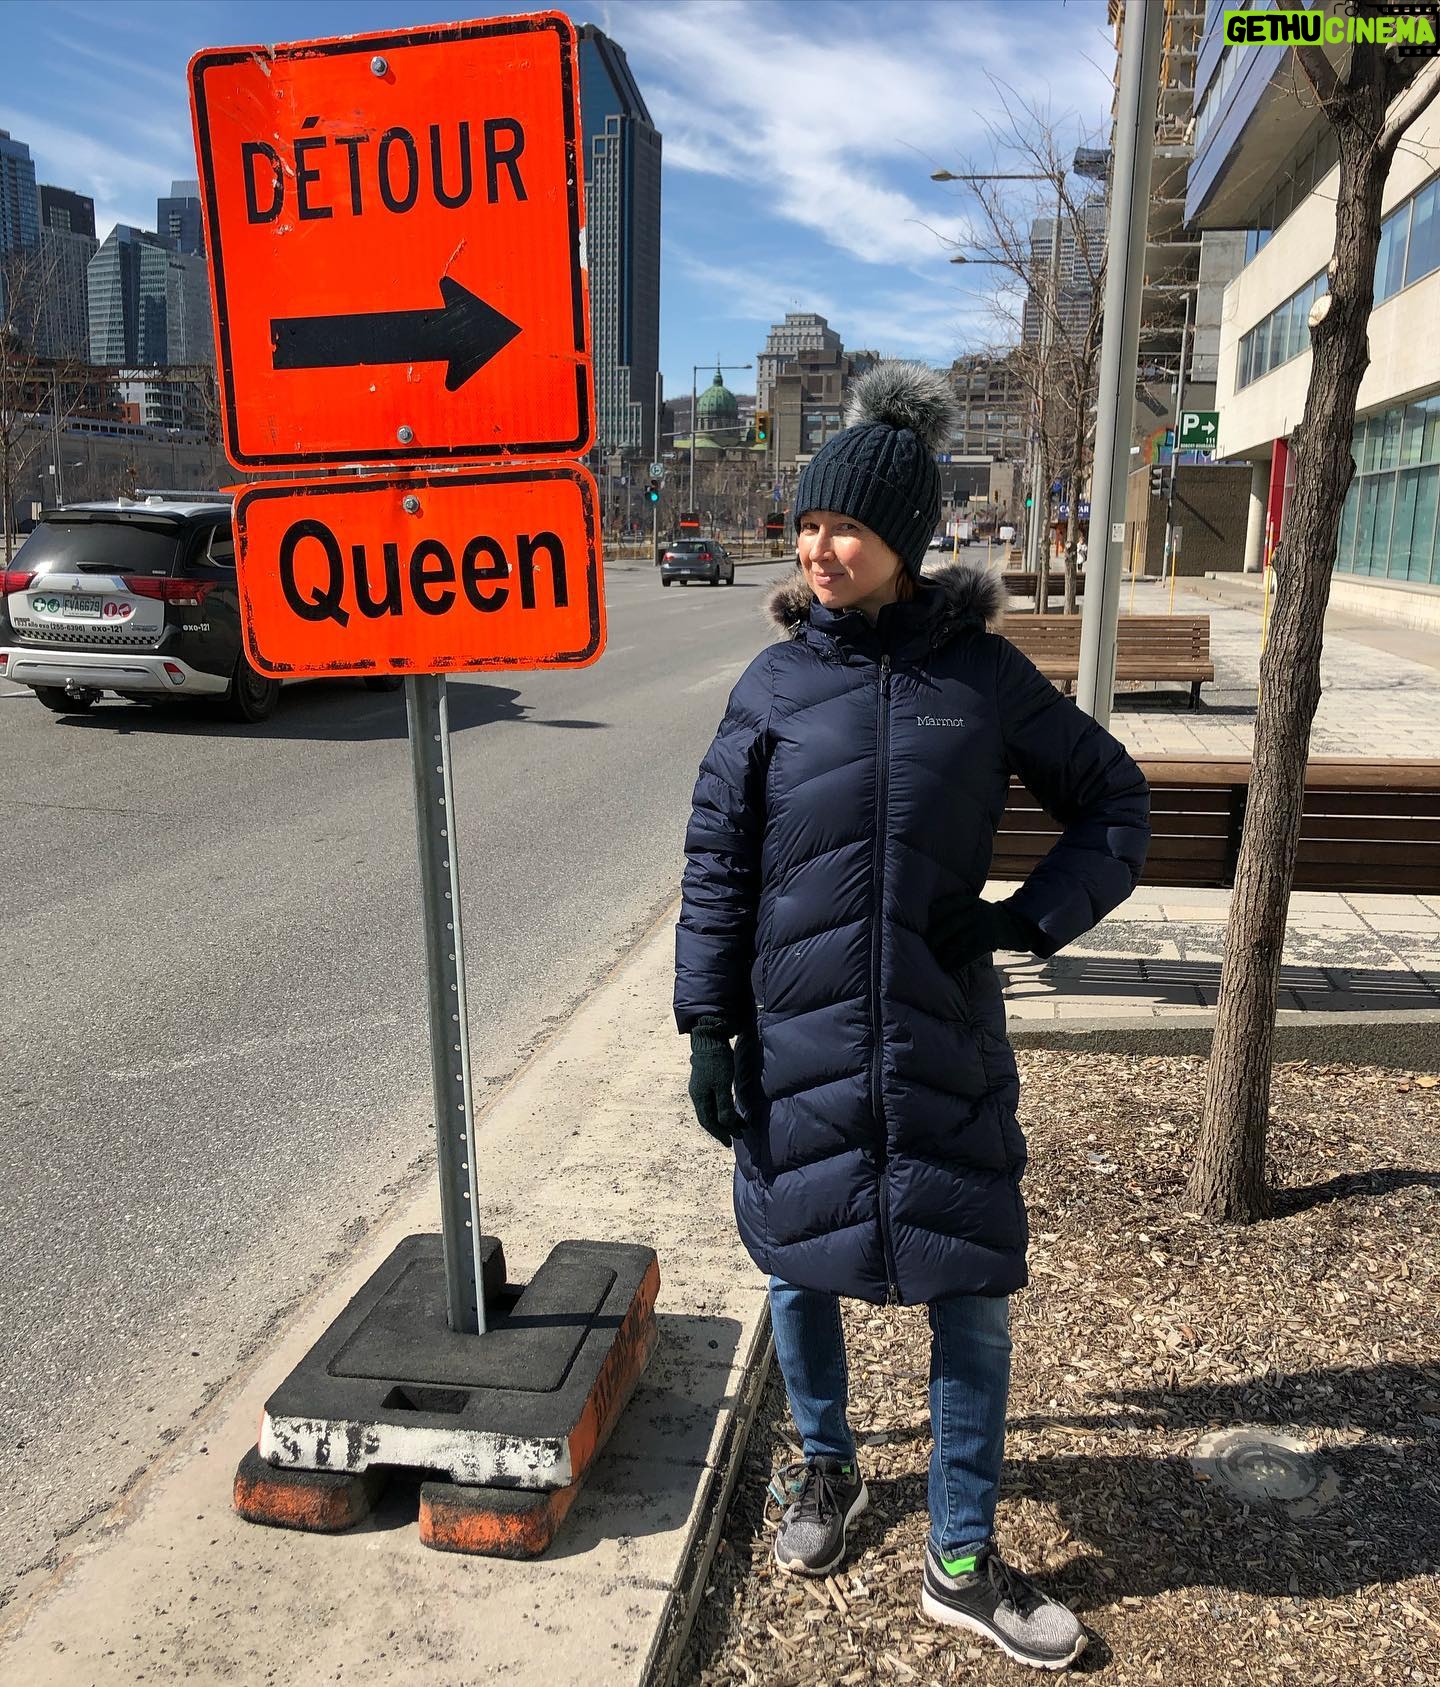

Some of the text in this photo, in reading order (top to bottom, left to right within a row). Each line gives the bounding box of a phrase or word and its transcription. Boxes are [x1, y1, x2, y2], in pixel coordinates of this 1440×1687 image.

[240, 115, 529, 225] DÉTOUR
[1182, 413, 1200, 436] P
[278, 518, 569, 629] Queen
[91, 625, 123, 633] exo-121
[182, 623, 210, 632] exo-121
[916, 715, 966, 728] Marmot
